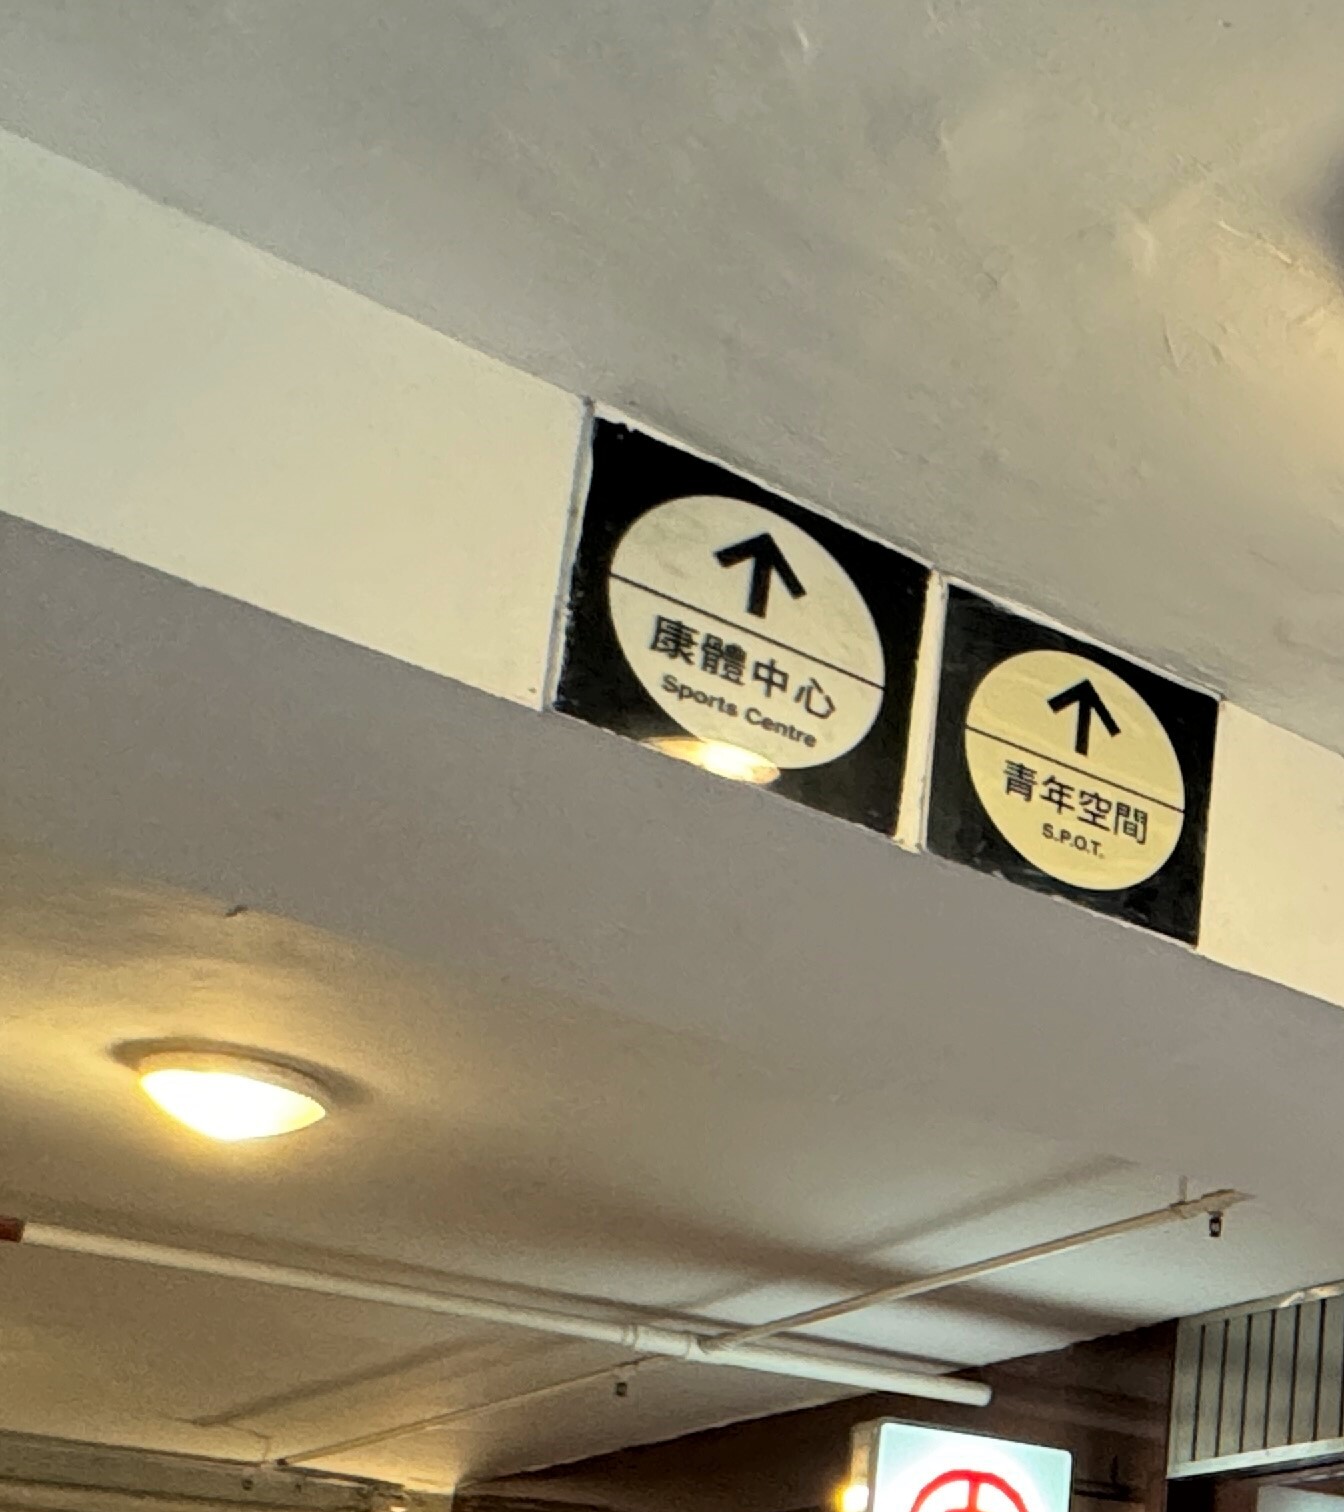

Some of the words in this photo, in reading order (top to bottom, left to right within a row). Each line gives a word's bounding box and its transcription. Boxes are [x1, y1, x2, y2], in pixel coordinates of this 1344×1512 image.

[649, 614, 836, 719] 康體中心
[661, 673, 738, 717] Sports
[745, 707, 817, 748] Centre
[1003, 760, 1148, 845] 青年空間
[1042, 823, 1104, 859] S.P.O.T.
